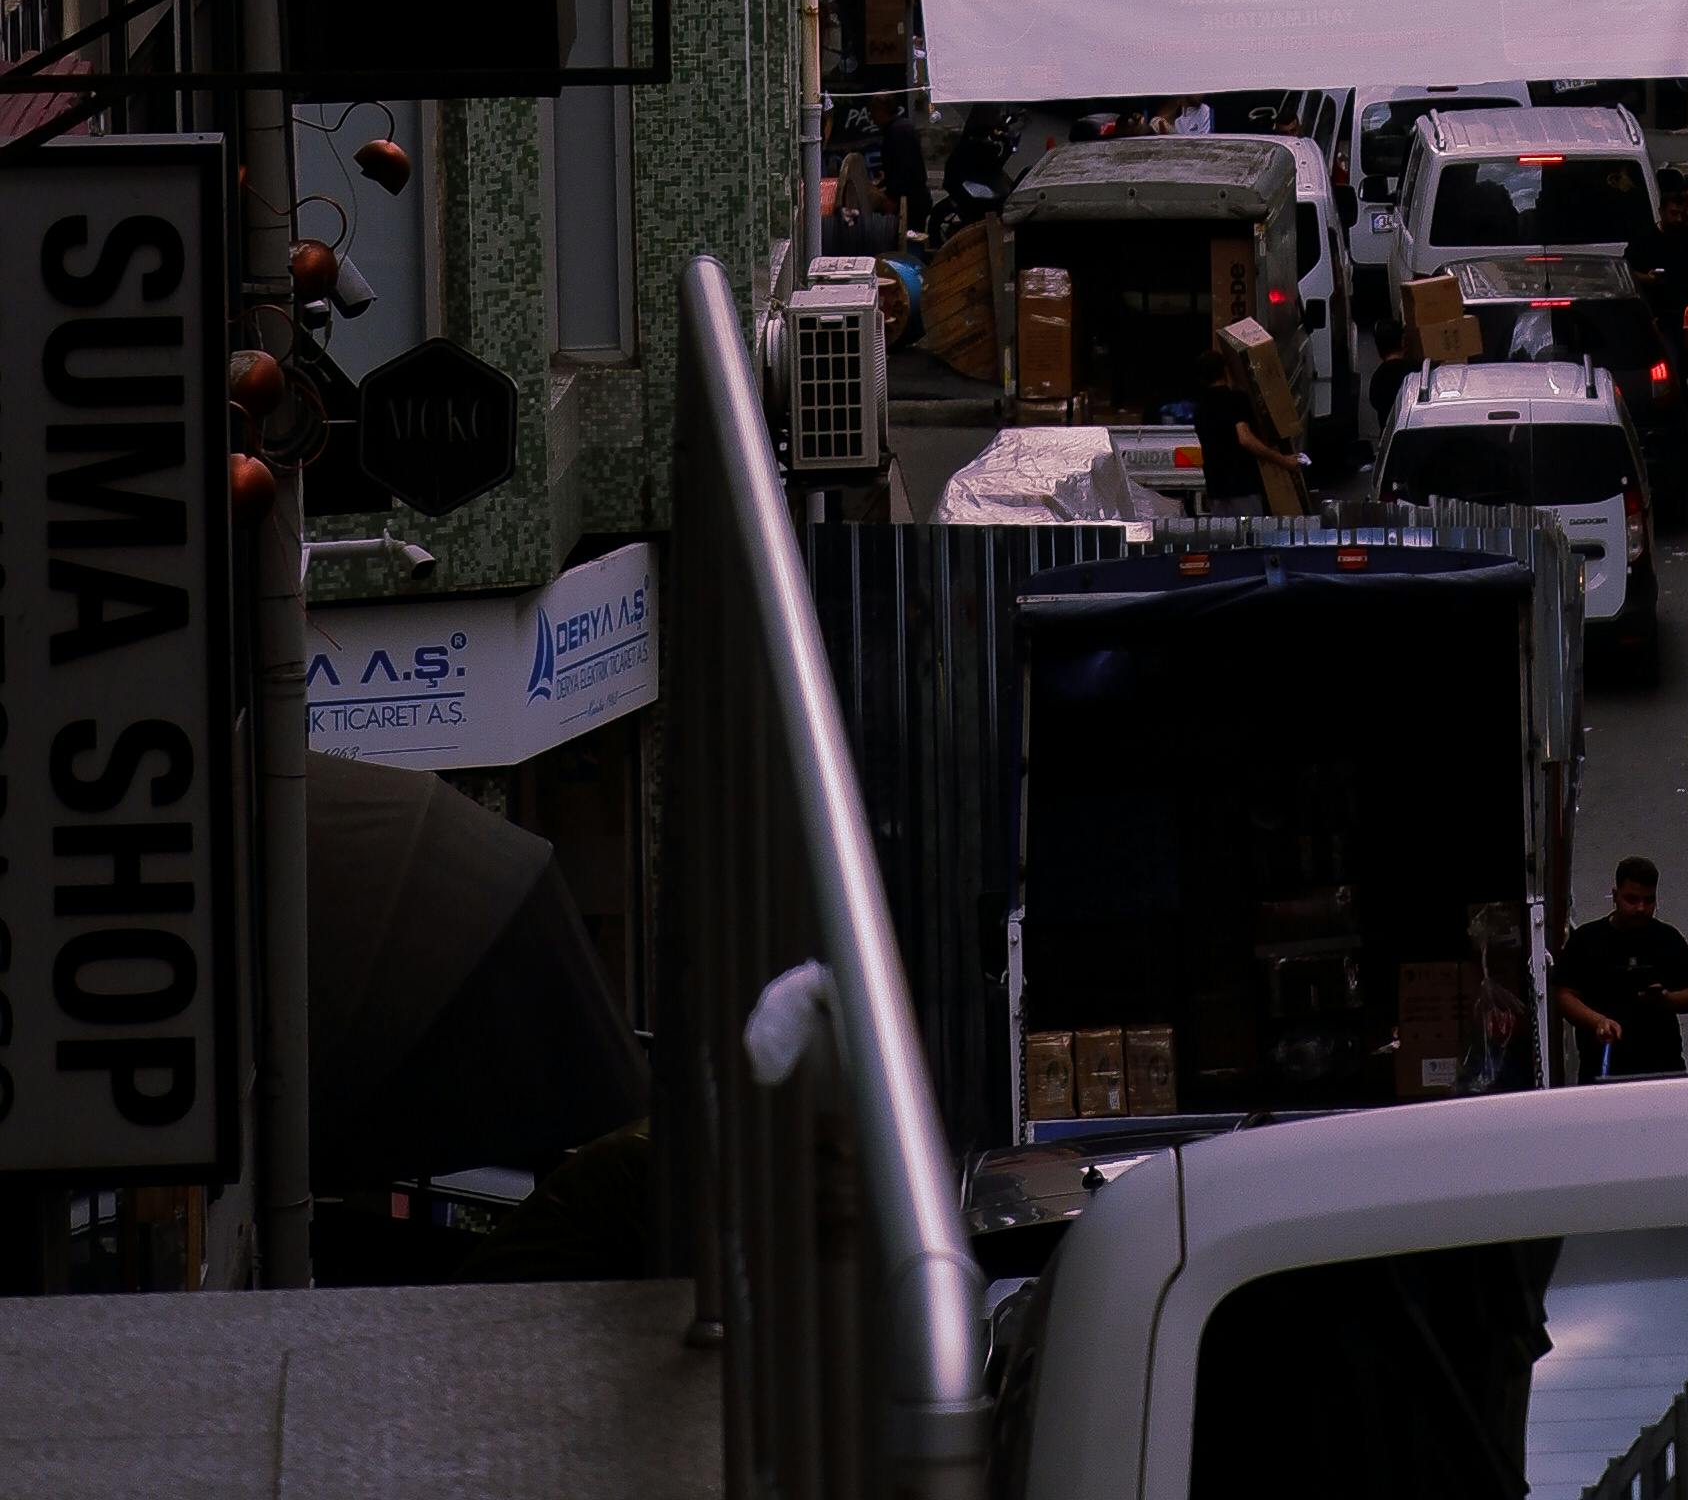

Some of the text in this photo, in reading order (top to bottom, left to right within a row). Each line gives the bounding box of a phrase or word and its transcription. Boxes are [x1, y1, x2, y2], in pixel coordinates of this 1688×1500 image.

[555, 601, 614, 657] DERYA
[40, 212, 199, 1128] SUMA SHOP
[329, 702, 422, 732] TİCARET
[426, 699, 467, 728] A.Ş.
